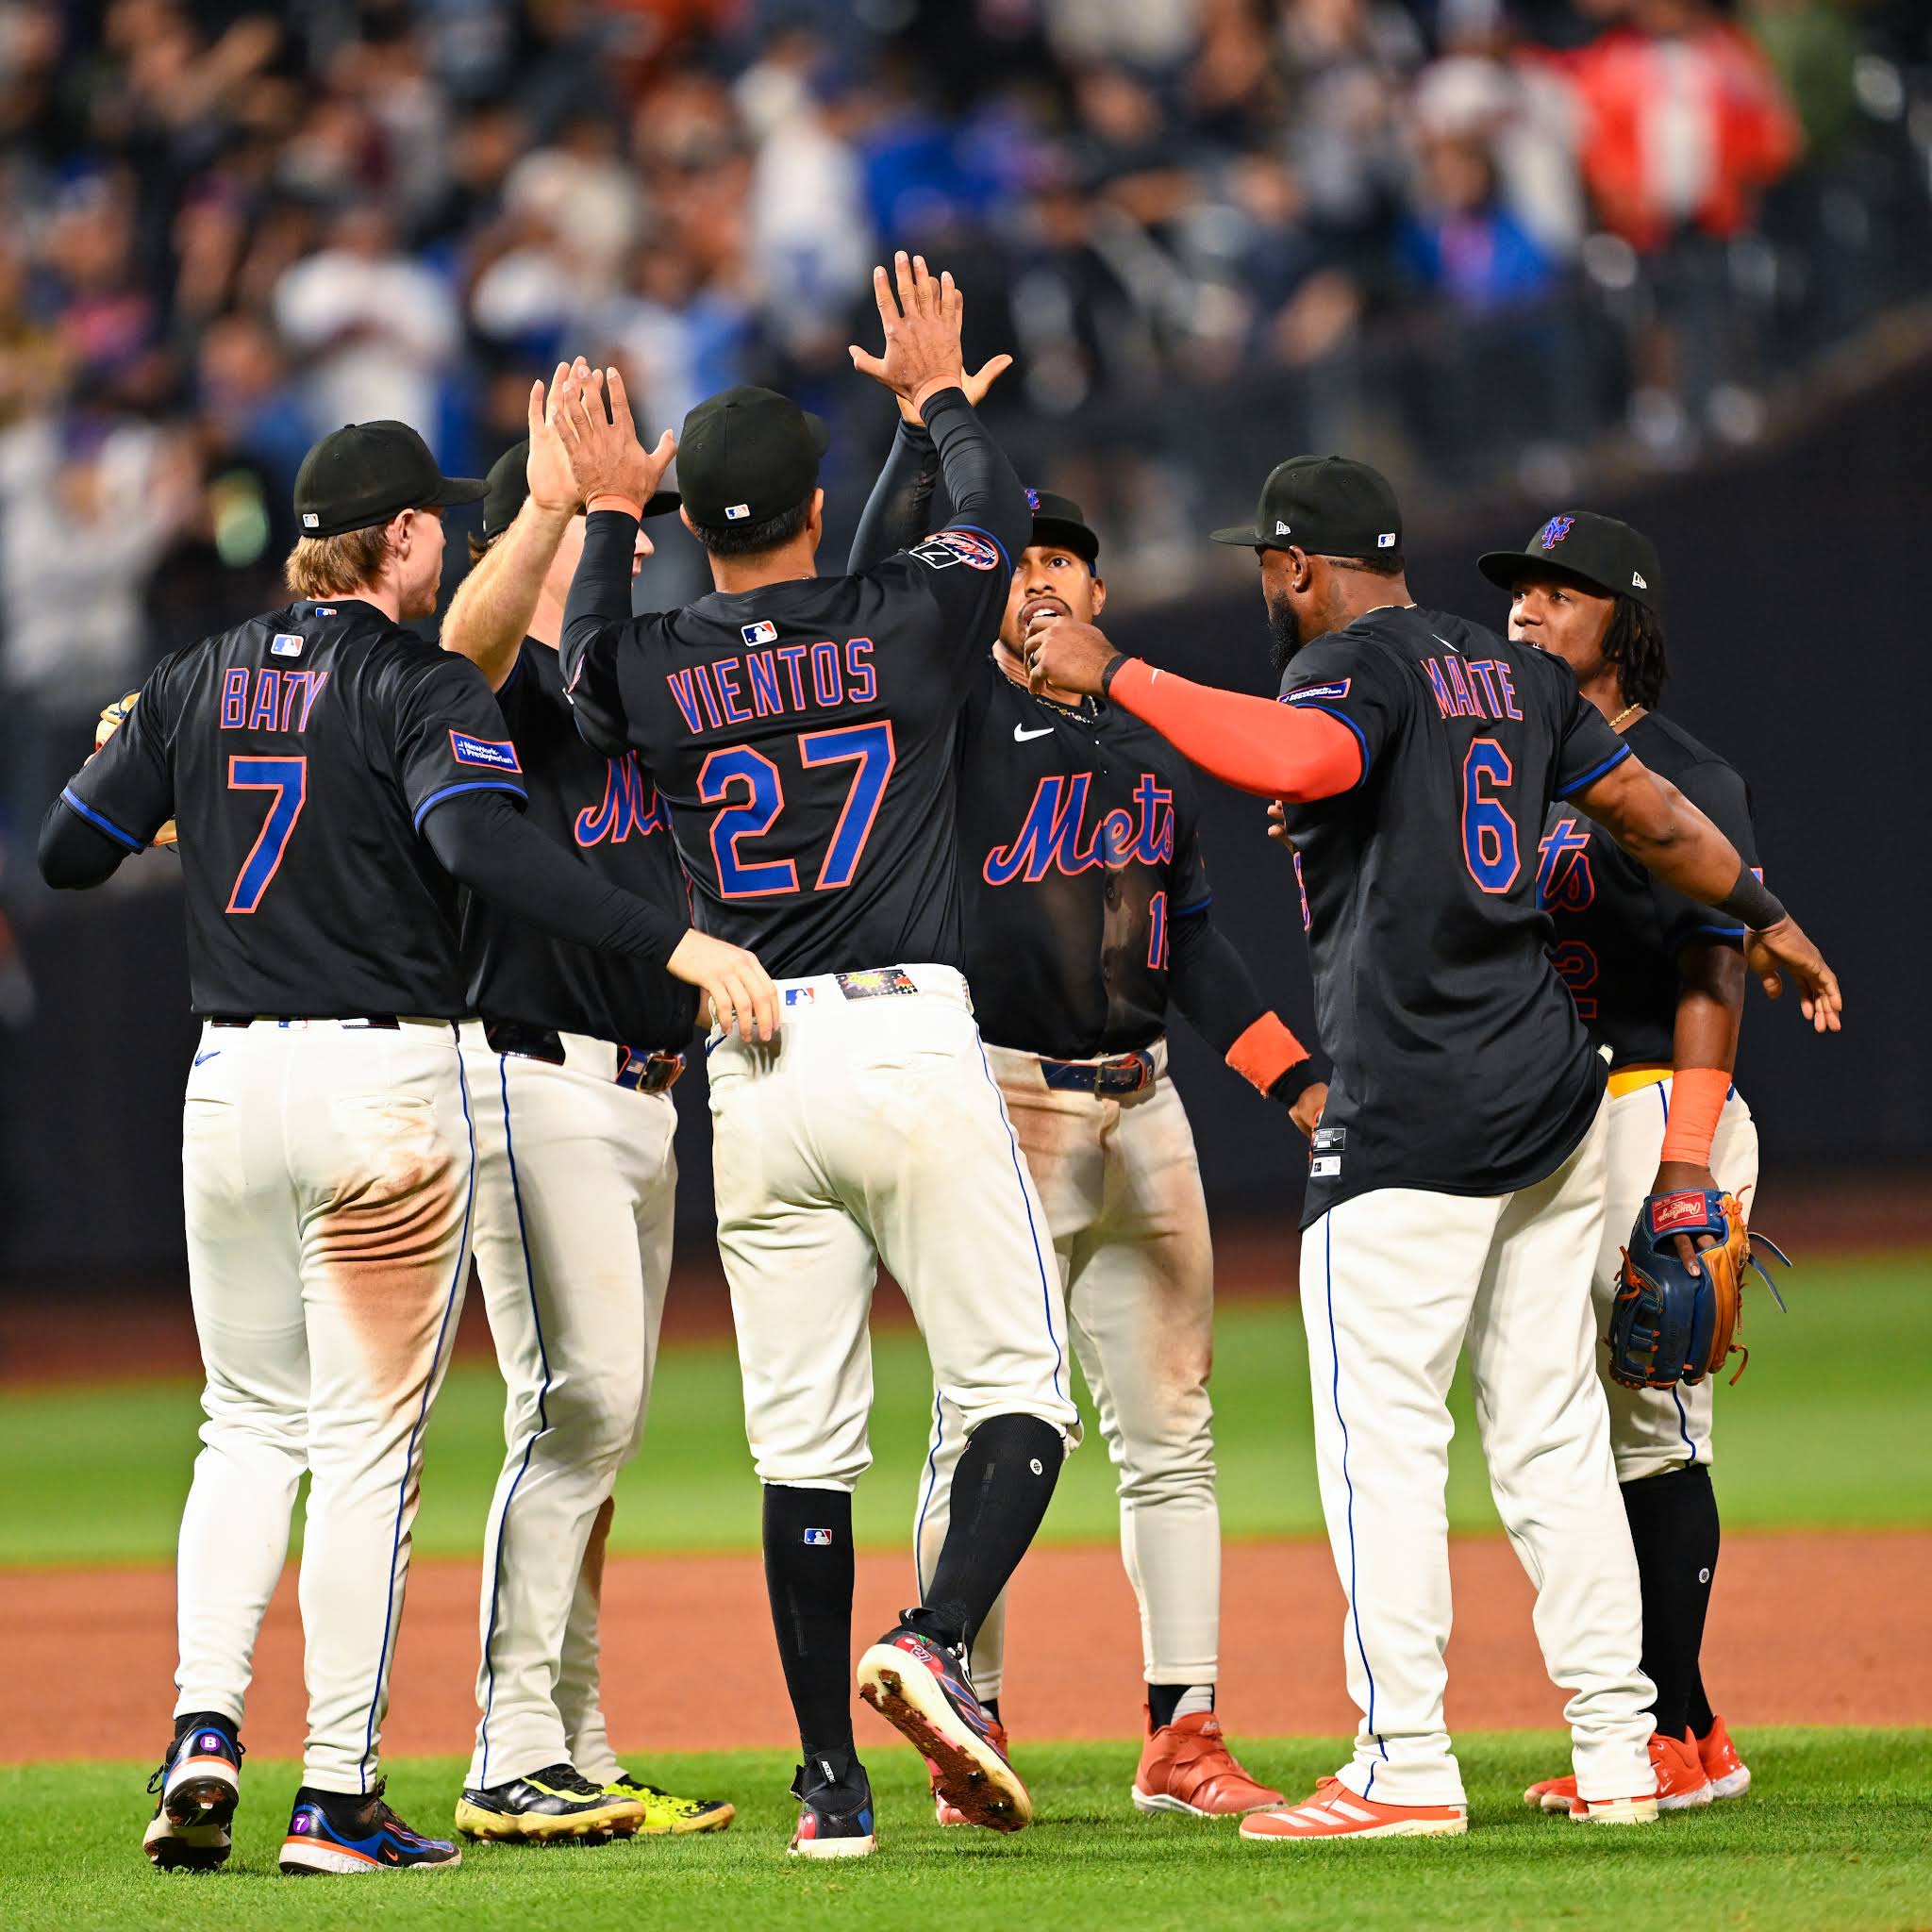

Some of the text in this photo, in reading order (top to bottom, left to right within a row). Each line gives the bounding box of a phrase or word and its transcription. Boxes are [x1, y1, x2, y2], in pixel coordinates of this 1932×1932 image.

[220, 667, 328, 732] BATY
[666, 638, 878, 735] VIENTOS
[225, 755, 308, 914] 7
[696, 719, 896, 899] 27
[983, 772, 1174, 886] Mets
[1461, 737, 1522, 894] 6
[1147, 891, 1169, 971] 1
[909, 1644, 933, 1662] 27
[204, 1736, 217, 1748] B
[296, 1817, 307, 1831] 7
